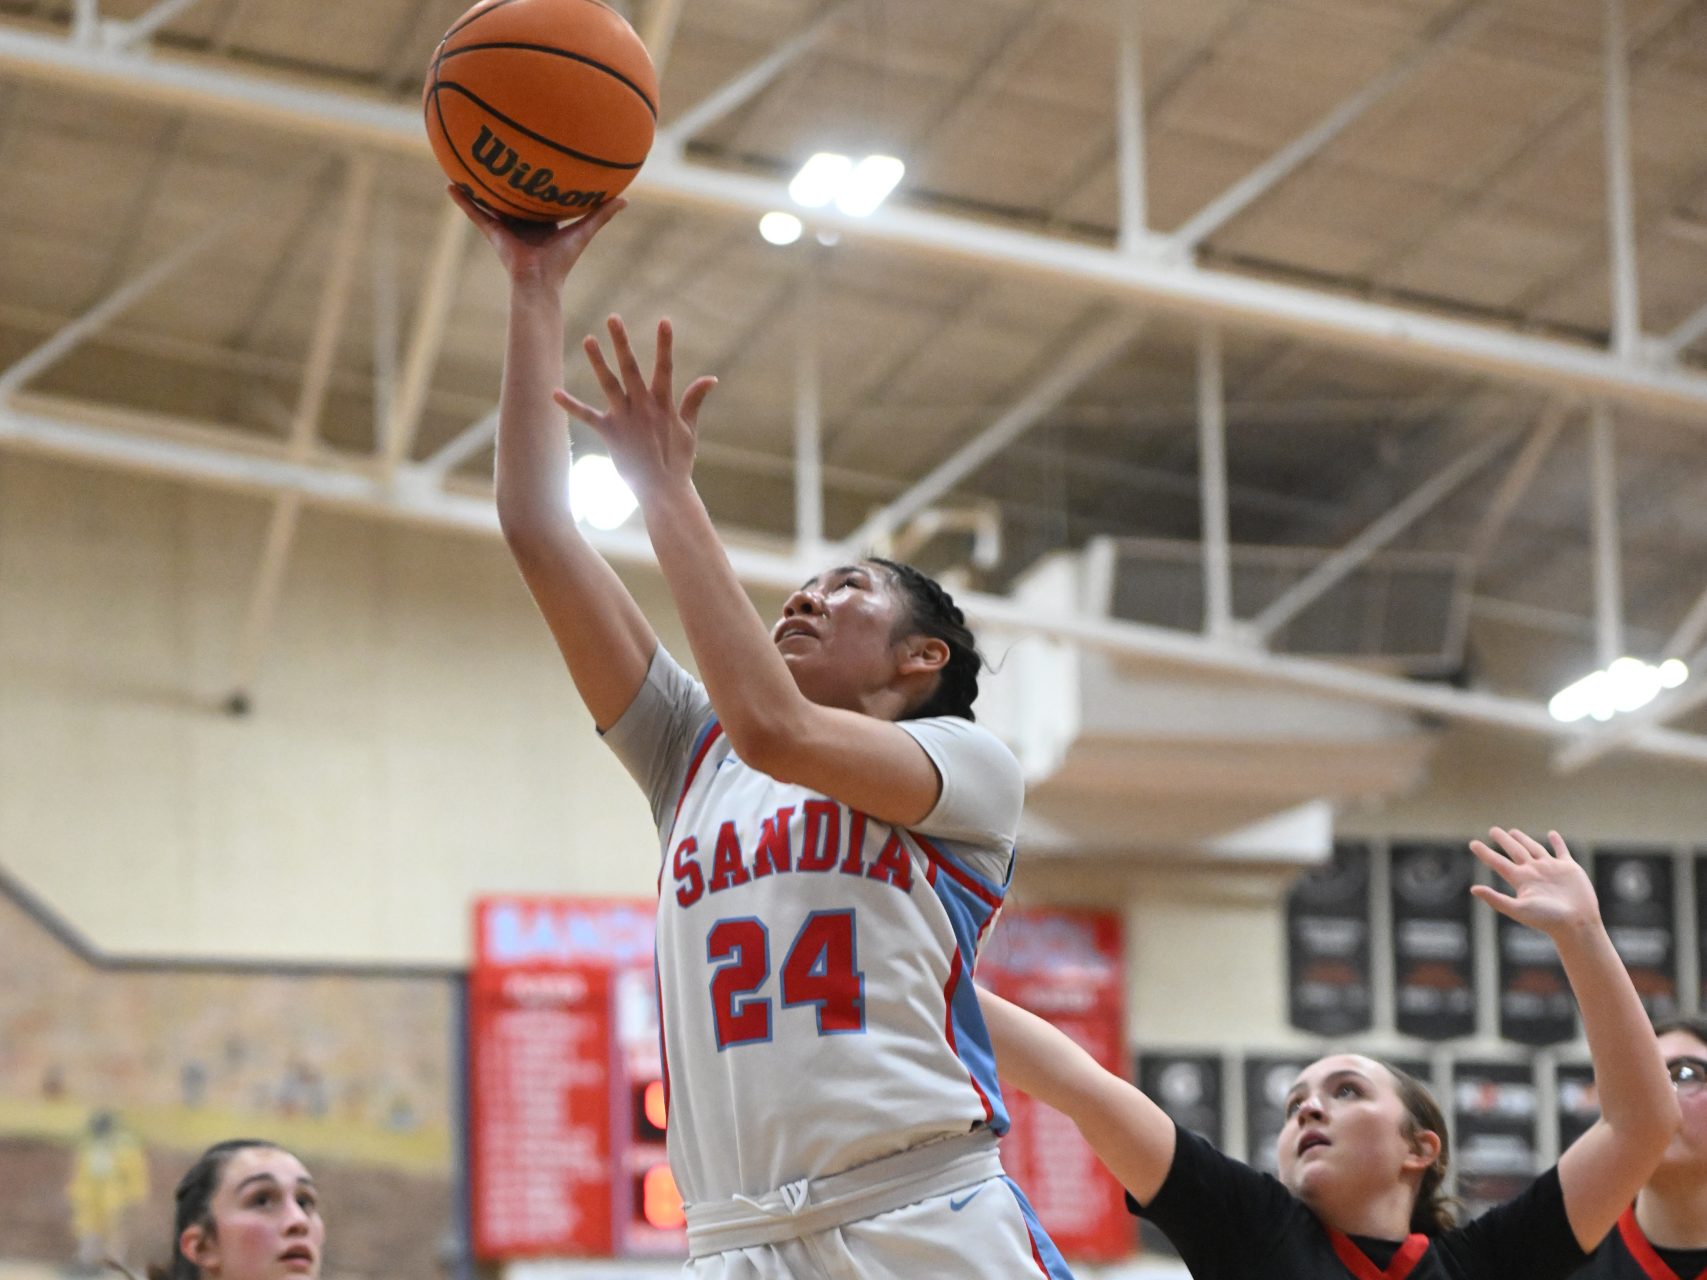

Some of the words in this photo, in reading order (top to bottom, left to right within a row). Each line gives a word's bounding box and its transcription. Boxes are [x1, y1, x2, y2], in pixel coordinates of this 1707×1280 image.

[471, 124, 607, 209] Wilson
[673, 798, 914, 909] SANDIA
[706, 907, 867, 1052] 24
